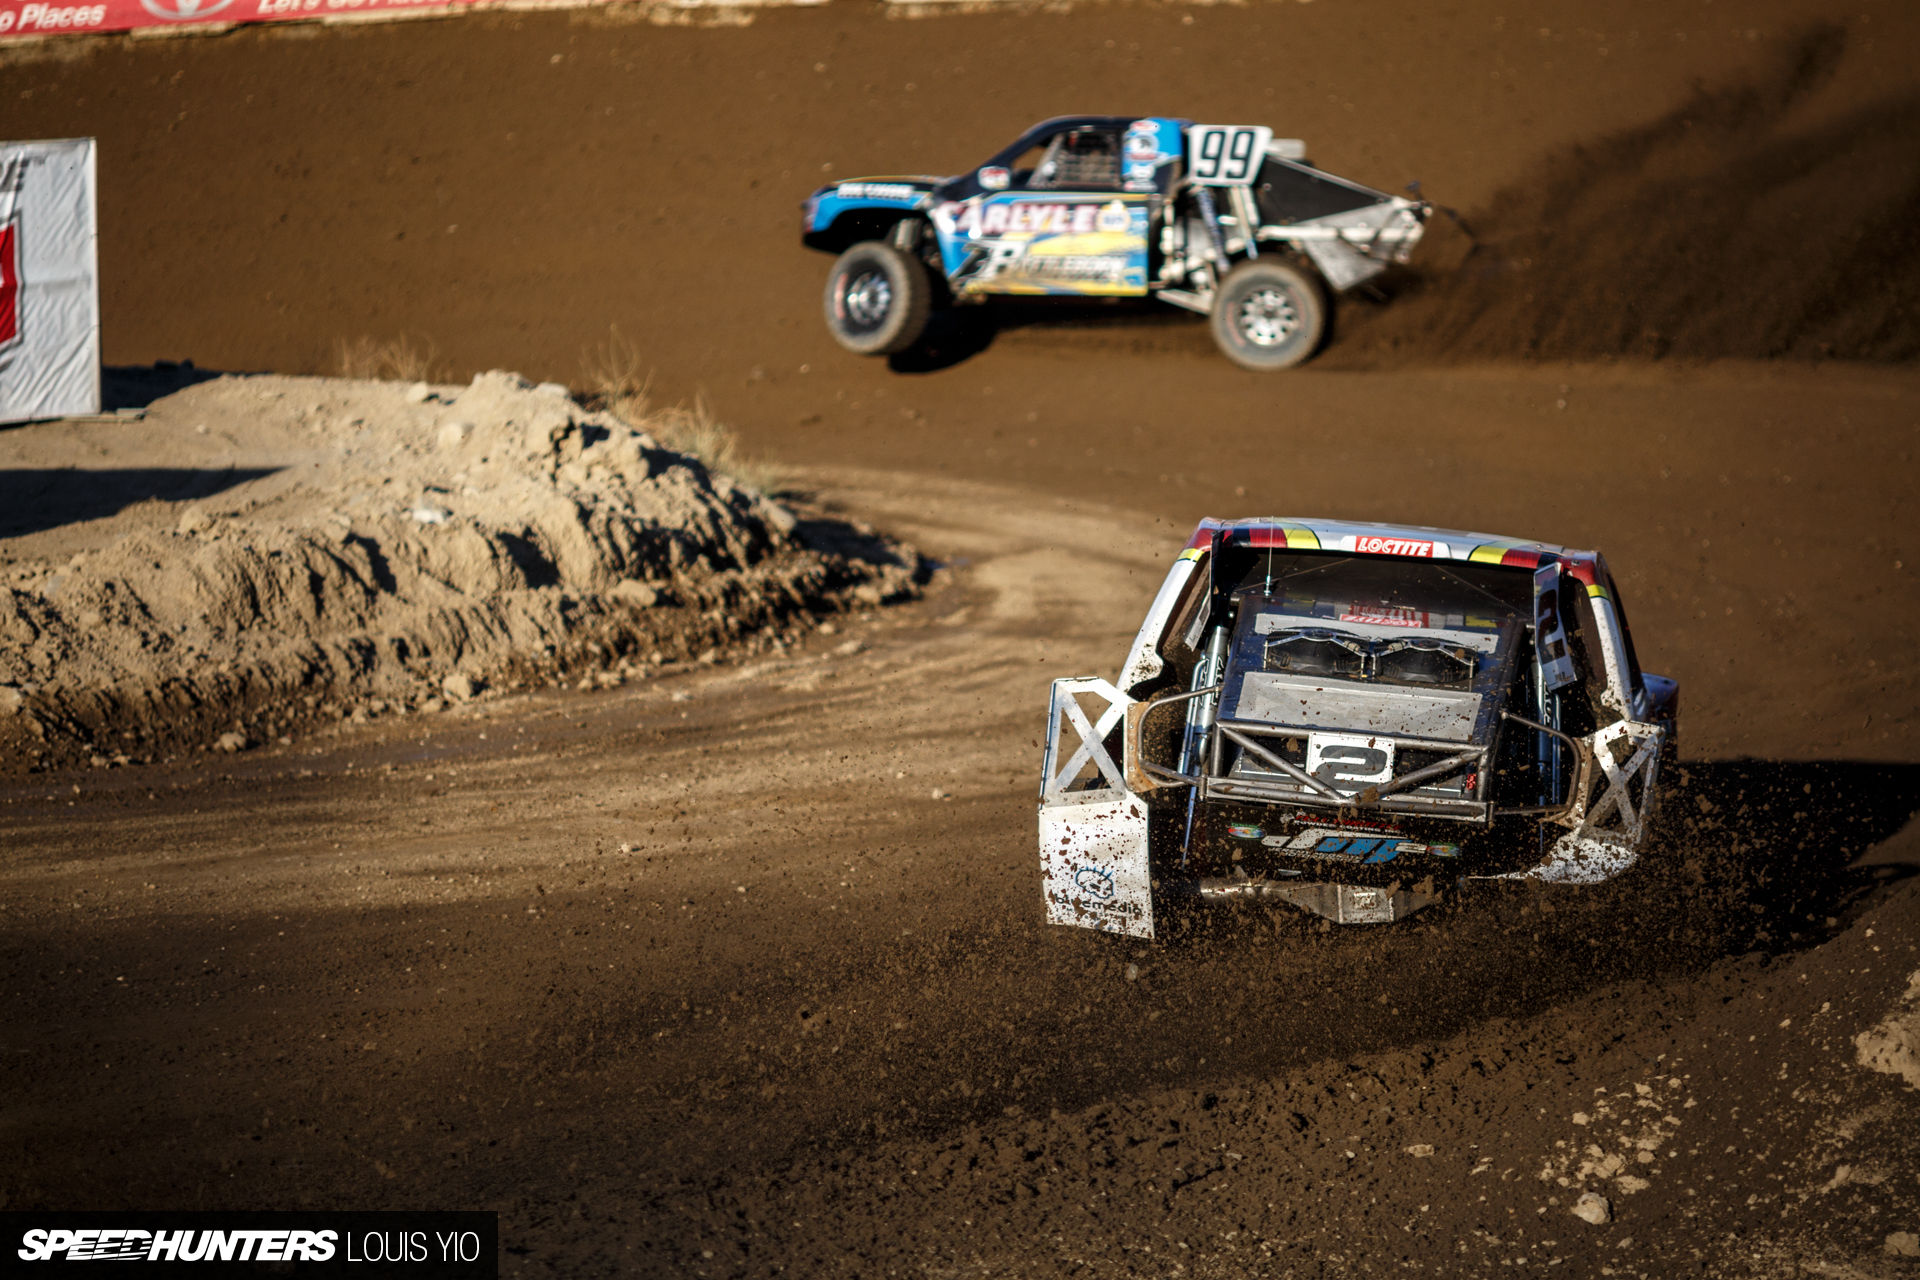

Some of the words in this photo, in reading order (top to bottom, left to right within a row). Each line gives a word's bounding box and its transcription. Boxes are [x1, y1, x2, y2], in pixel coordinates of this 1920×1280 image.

[0, 9, 16, 32] o
[17, 2, 107, 31] Places
[1197, 131, 1254, 178] 99
[931, 201, 1098, 233] CARLYLE
[1357, 537, 1432, 556] LOCTITE
[1315, 745, 1387, 792] 2
